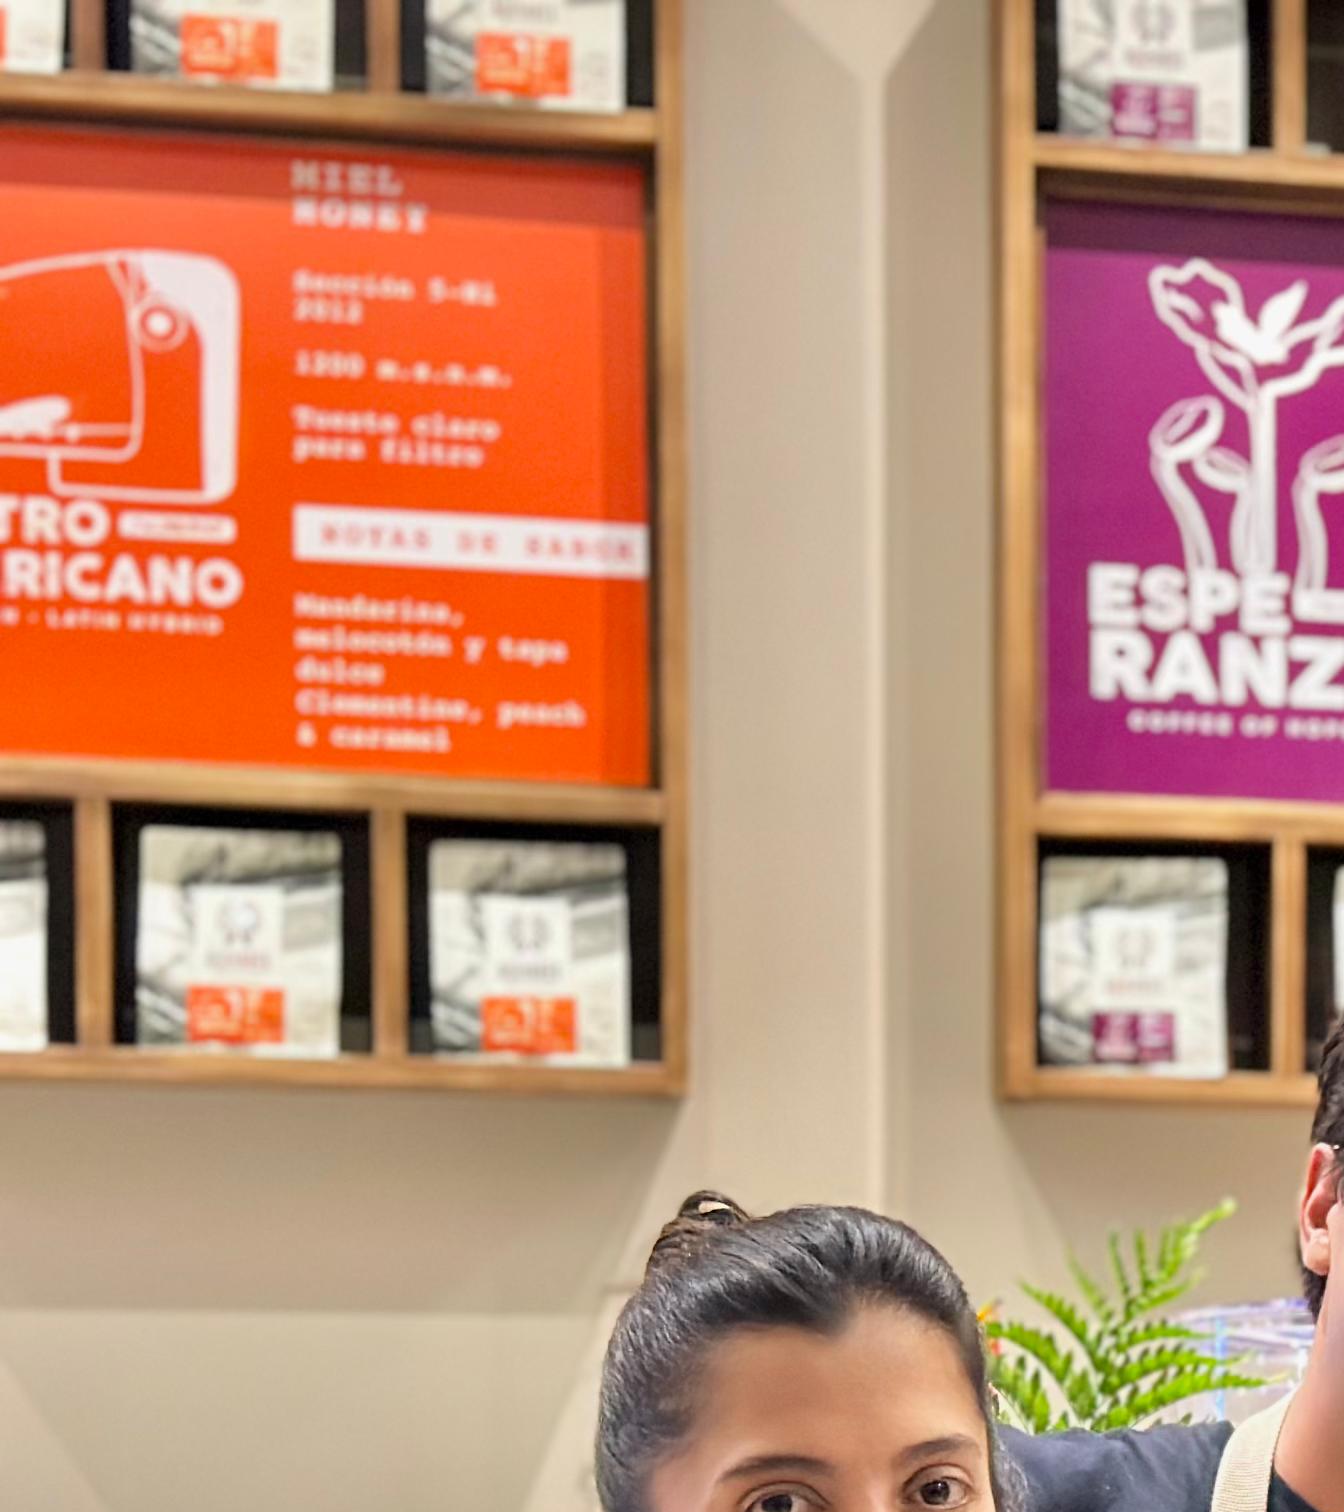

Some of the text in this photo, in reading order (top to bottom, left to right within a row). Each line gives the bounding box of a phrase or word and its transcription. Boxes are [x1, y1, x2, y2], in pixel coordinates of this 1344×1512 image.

[291, 160, 403, 197] MIEL
[292, 196, 427, 234] HONEY
[410, 411, 502, 442] claro
[292, 435, 366, 463] para
[457, 530, 497, 552] DE
[3, 551, 243, 608] RICANO
[1087, 561, 1291, 635] ESPE
